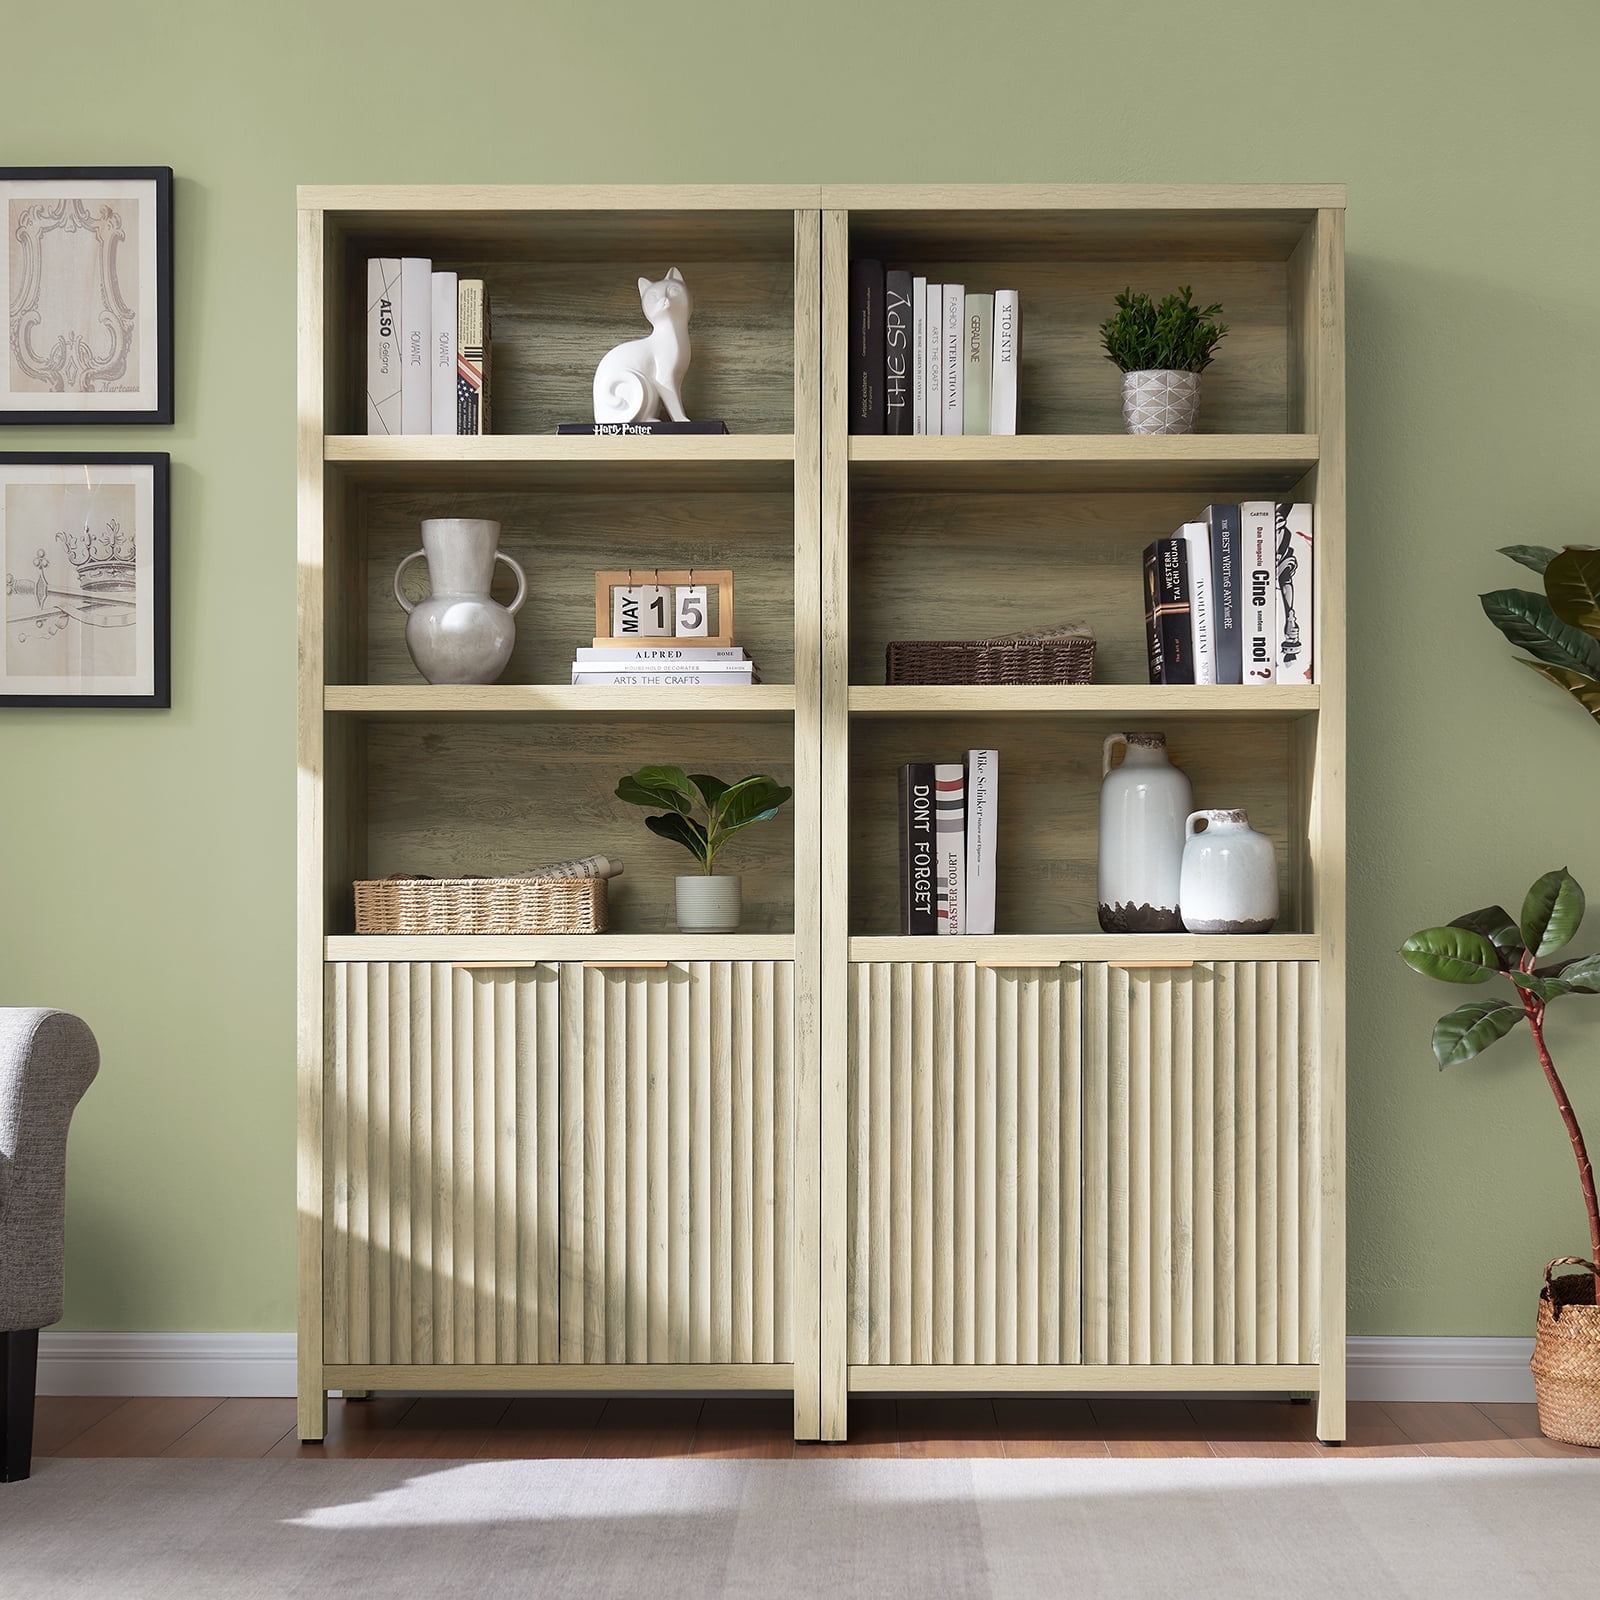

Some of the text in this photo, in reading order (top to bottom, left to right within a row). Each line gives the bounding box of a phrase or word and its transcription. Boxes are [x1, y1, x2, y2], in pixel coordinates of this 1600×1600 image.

[379, 298, 392, 337] ALSO
[1002, 304, 1012, 362] KINFOLK
[410, 331, 421, 367] ROMANTIC
[439, 332, 450, 368] ROMANTIC
[887, 290, 912, 415] THE SPY
[949, 296, 957, 410] FASHION INTERNATIONAL
[971, 315, 980, 363] GERALDINE
[381, 342, 391, 374] Gelang
[592, 423, 652, 435] Harry Potter
[1222, 531, 1230, 553] BEST
[1164, 551, 1173, 589] WESTERN
[1170, 540, 1181, 600] TAI CHI CHUAN
[1252, 570, 1270, 606] Cine
[622, 596, 638, 632] MAY
[635, 651, 682, 659] ALPRED
[1252, 637, 1270, 662] noi
[613, 676, 700, 685] ARTS THE CRAFTS
[976, 750, 987, 817] Mike Selinker
[913, 784, 931, 915] DONT FORGET
[949, 852, 958, 935] CRASTER COURT
